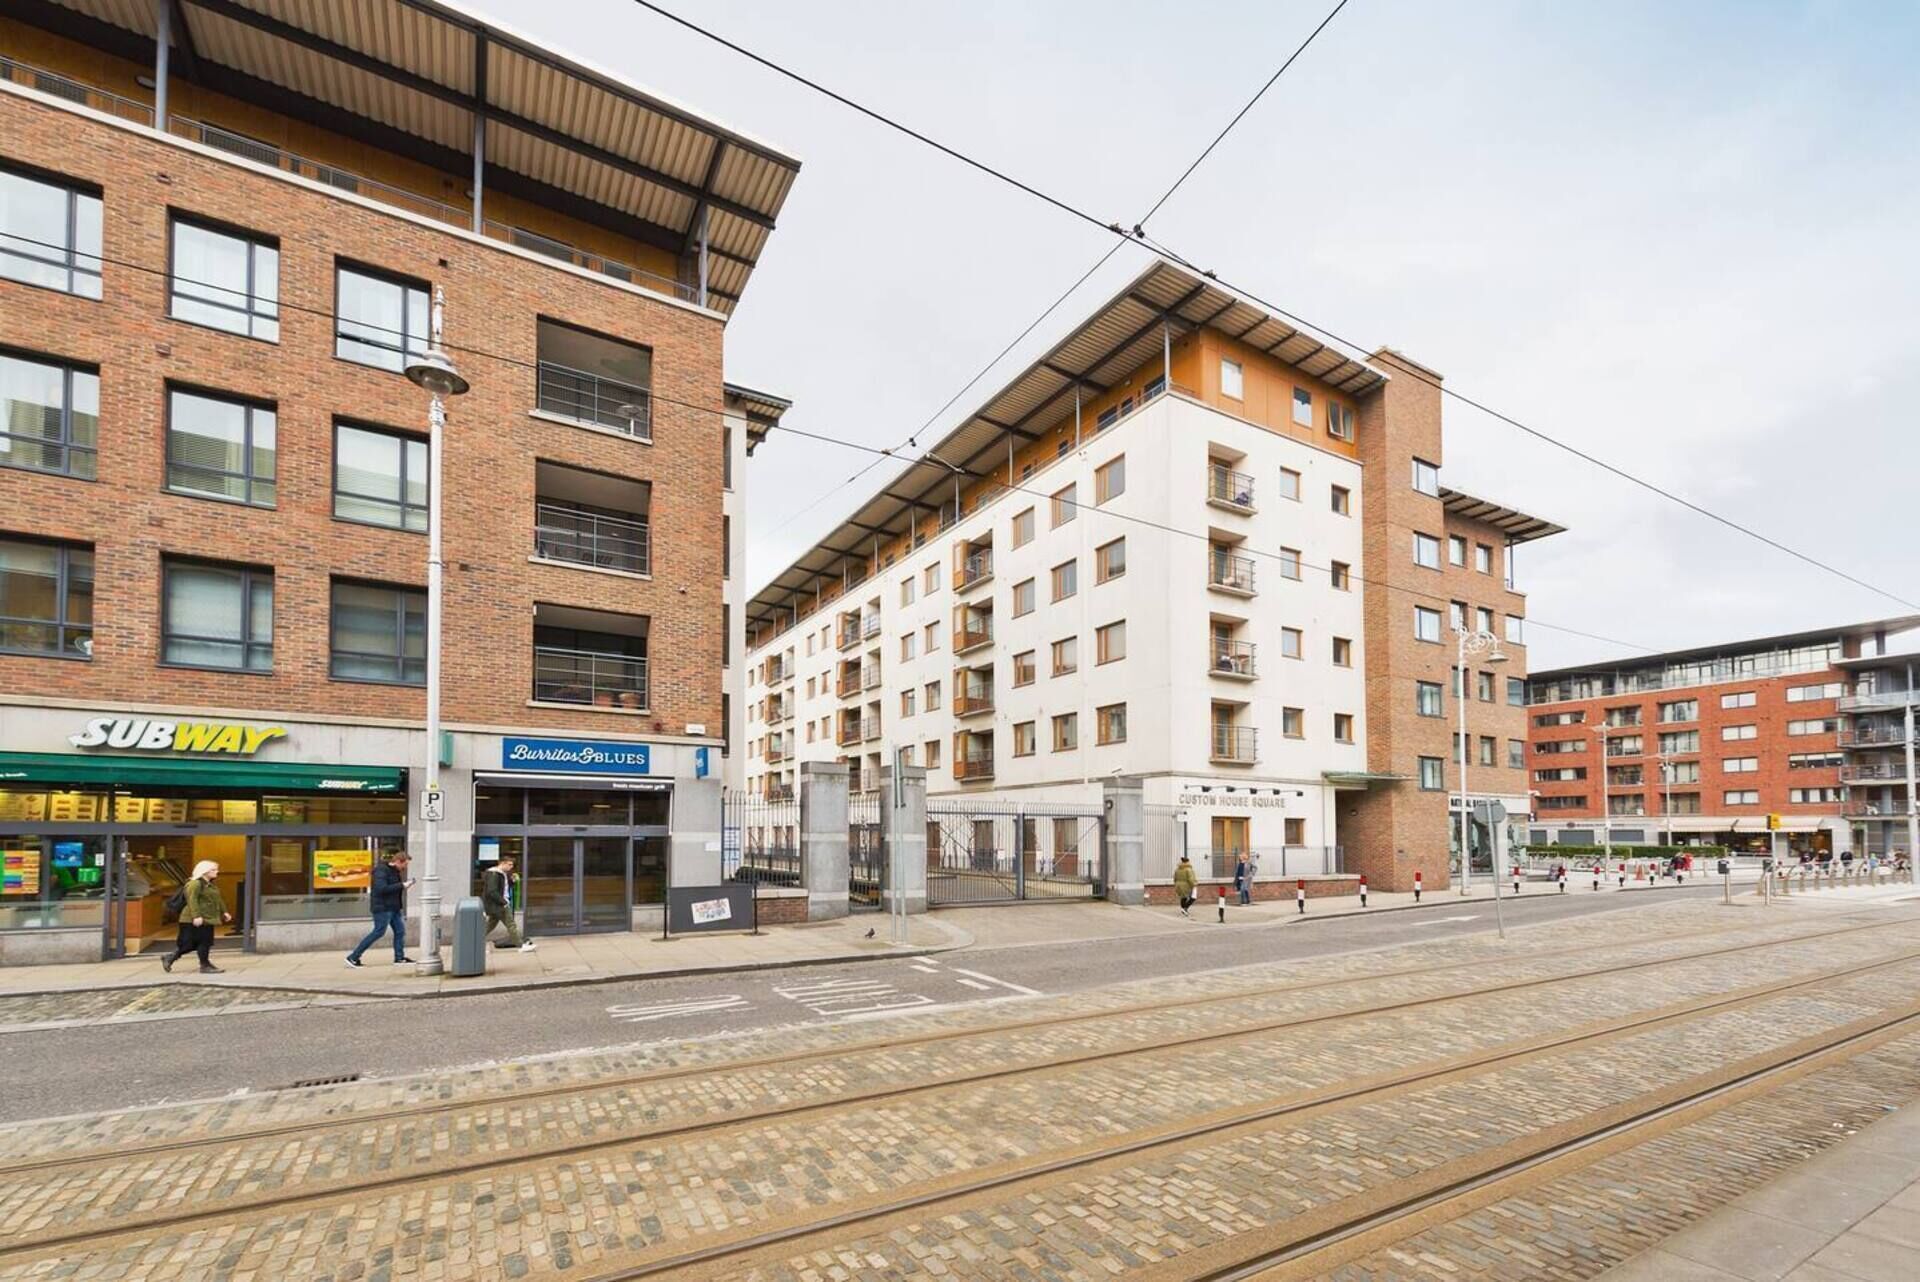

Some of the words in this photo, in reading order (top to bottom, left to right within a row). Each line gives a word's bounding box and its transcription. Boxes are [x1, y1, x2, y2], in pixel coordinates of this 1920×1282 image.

[68, 717, 288, 754] SUBWAY
[509, 744, 578, 761] Burritos
[596, 754, 645, 765] BLUES
[428, 793, 440, 805] P
[1178, 793, 1216, 806] CUSTOM
[1218, 796, 1249, 807] HOUSE
[1251, 799, 1286, 809] SQUARE
